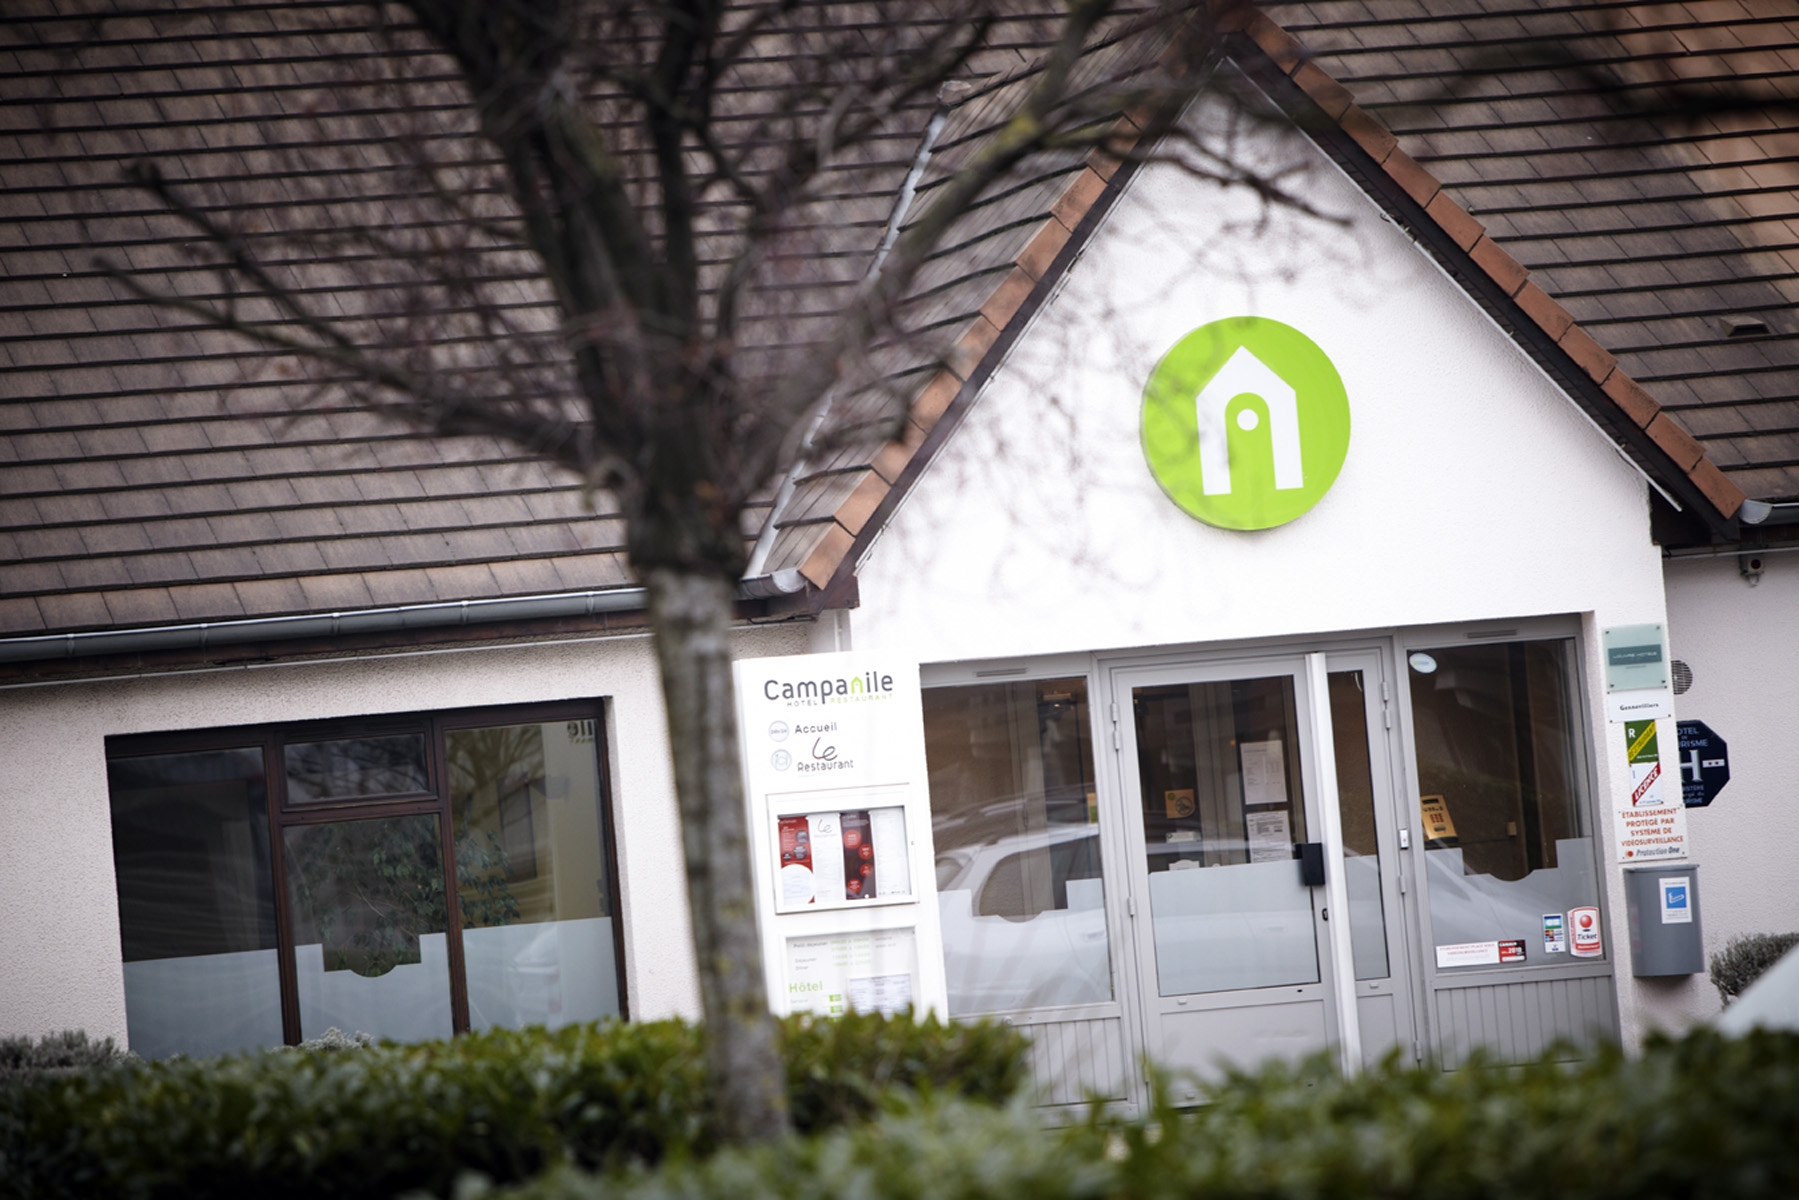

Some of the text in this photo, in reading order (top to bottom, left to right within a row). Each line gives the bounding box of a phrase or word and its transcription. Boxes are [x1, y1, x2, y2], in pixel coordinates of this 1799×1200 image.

[764, 671, 893, 704] Campanile
[830, 694, 893, 704] RESTAURANT
[794, 722, 838, 734] Accueil
[1628, 728, 1636, 738] R
[1677, 727, 1699, 736] OTEL
[812, 736, 838, 761] Le
[1680, 739, 1708, 747] RISME
[797, 760, 854, 772] Restaurant
[1636, 846, 1680, 856] Protection One
[789, 981, 823, 993] Hôtel
